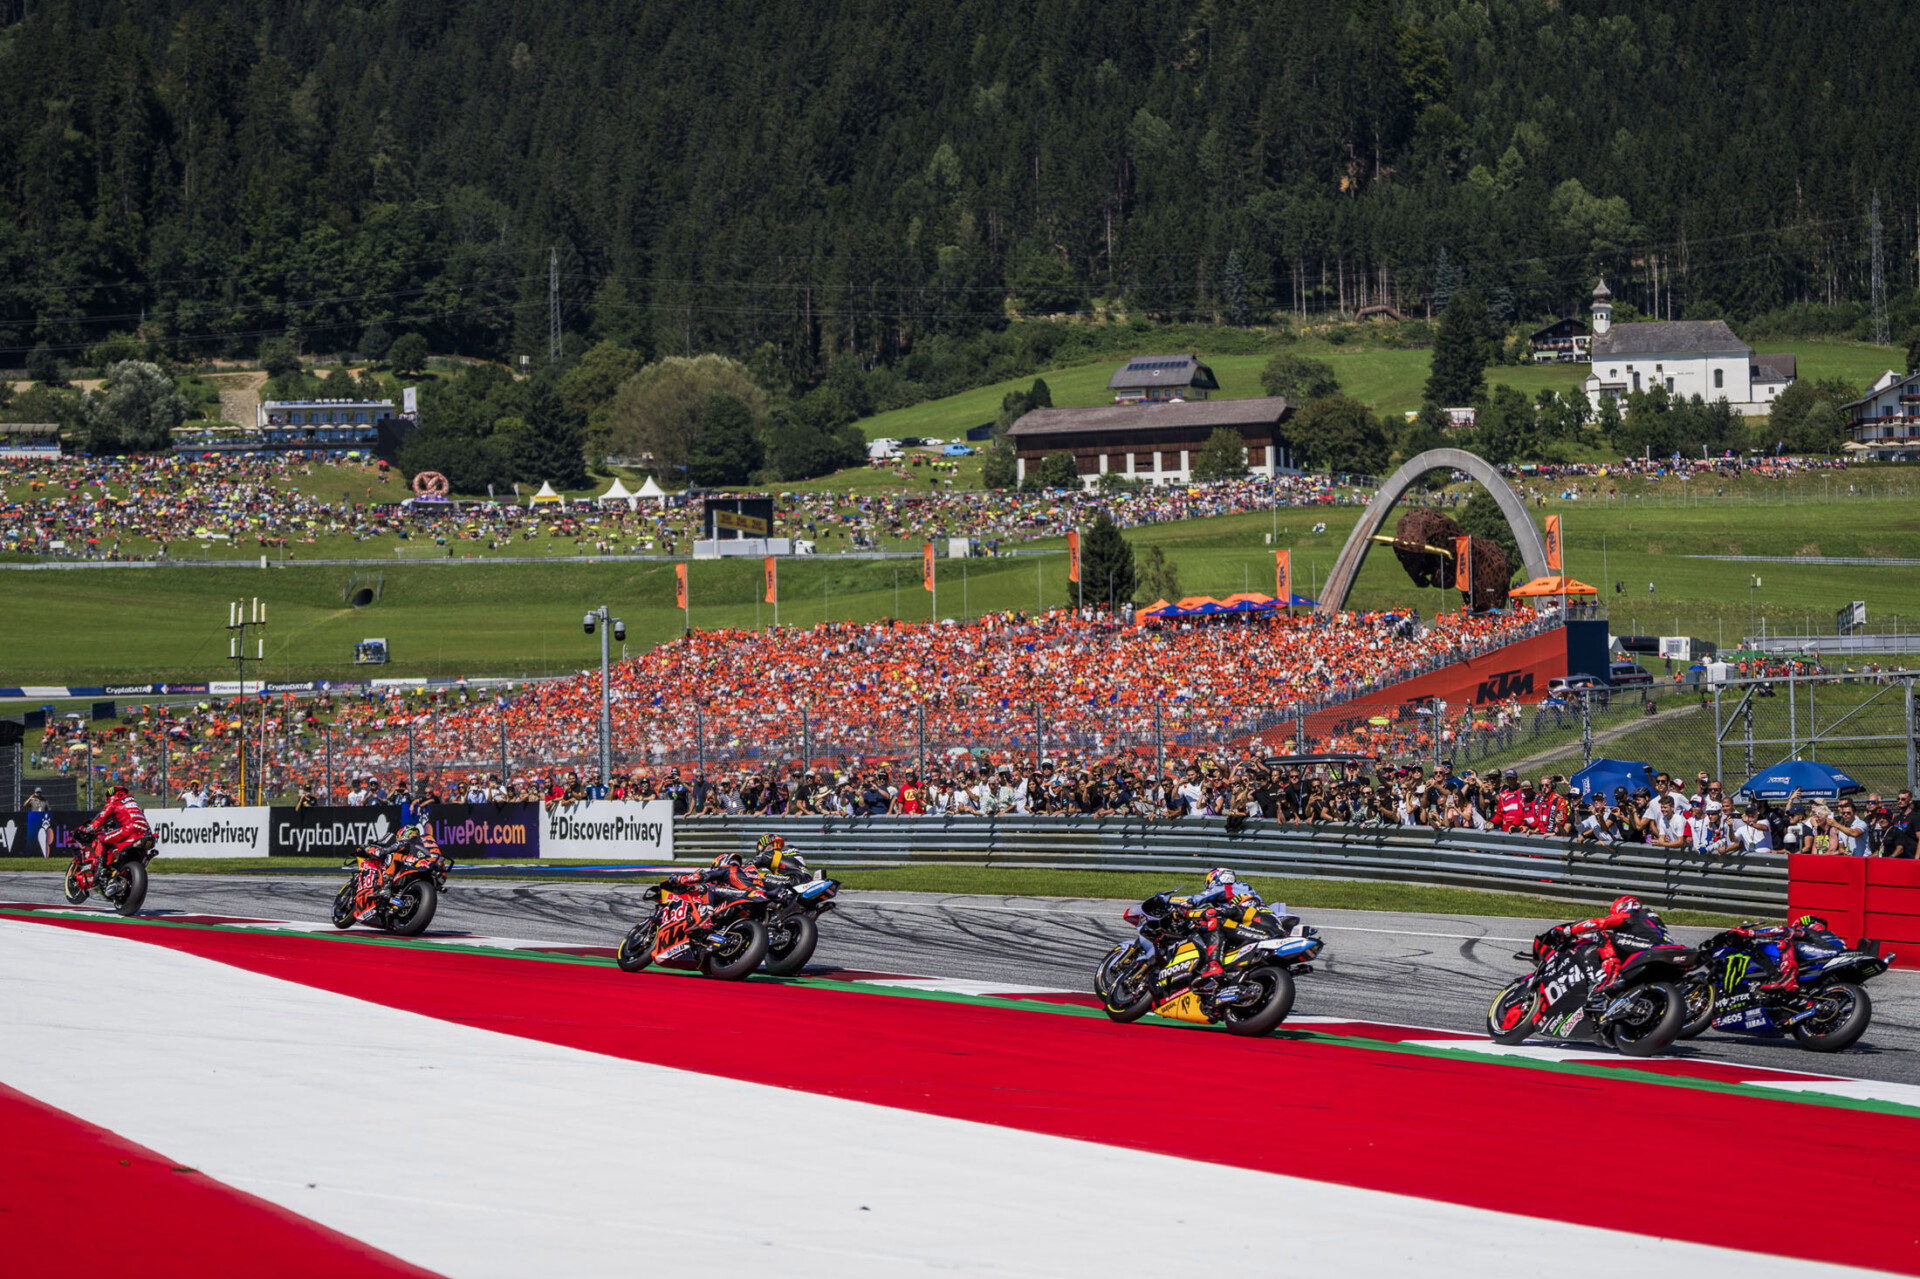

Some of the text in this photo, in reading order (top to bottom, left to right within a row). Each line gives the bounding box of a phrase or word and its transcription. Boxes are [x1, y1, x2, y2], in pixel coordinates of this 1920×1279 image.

[1476, 670, 1533, 704] KTM
[155, 820, 259, 849] #DiscoverPrivacy
[279, 822, 378, 852] CryptoDATA
[436, 819, 526, 845] LivePot.com
[550, 815, 662, 848] #DiscoverPrivacy
